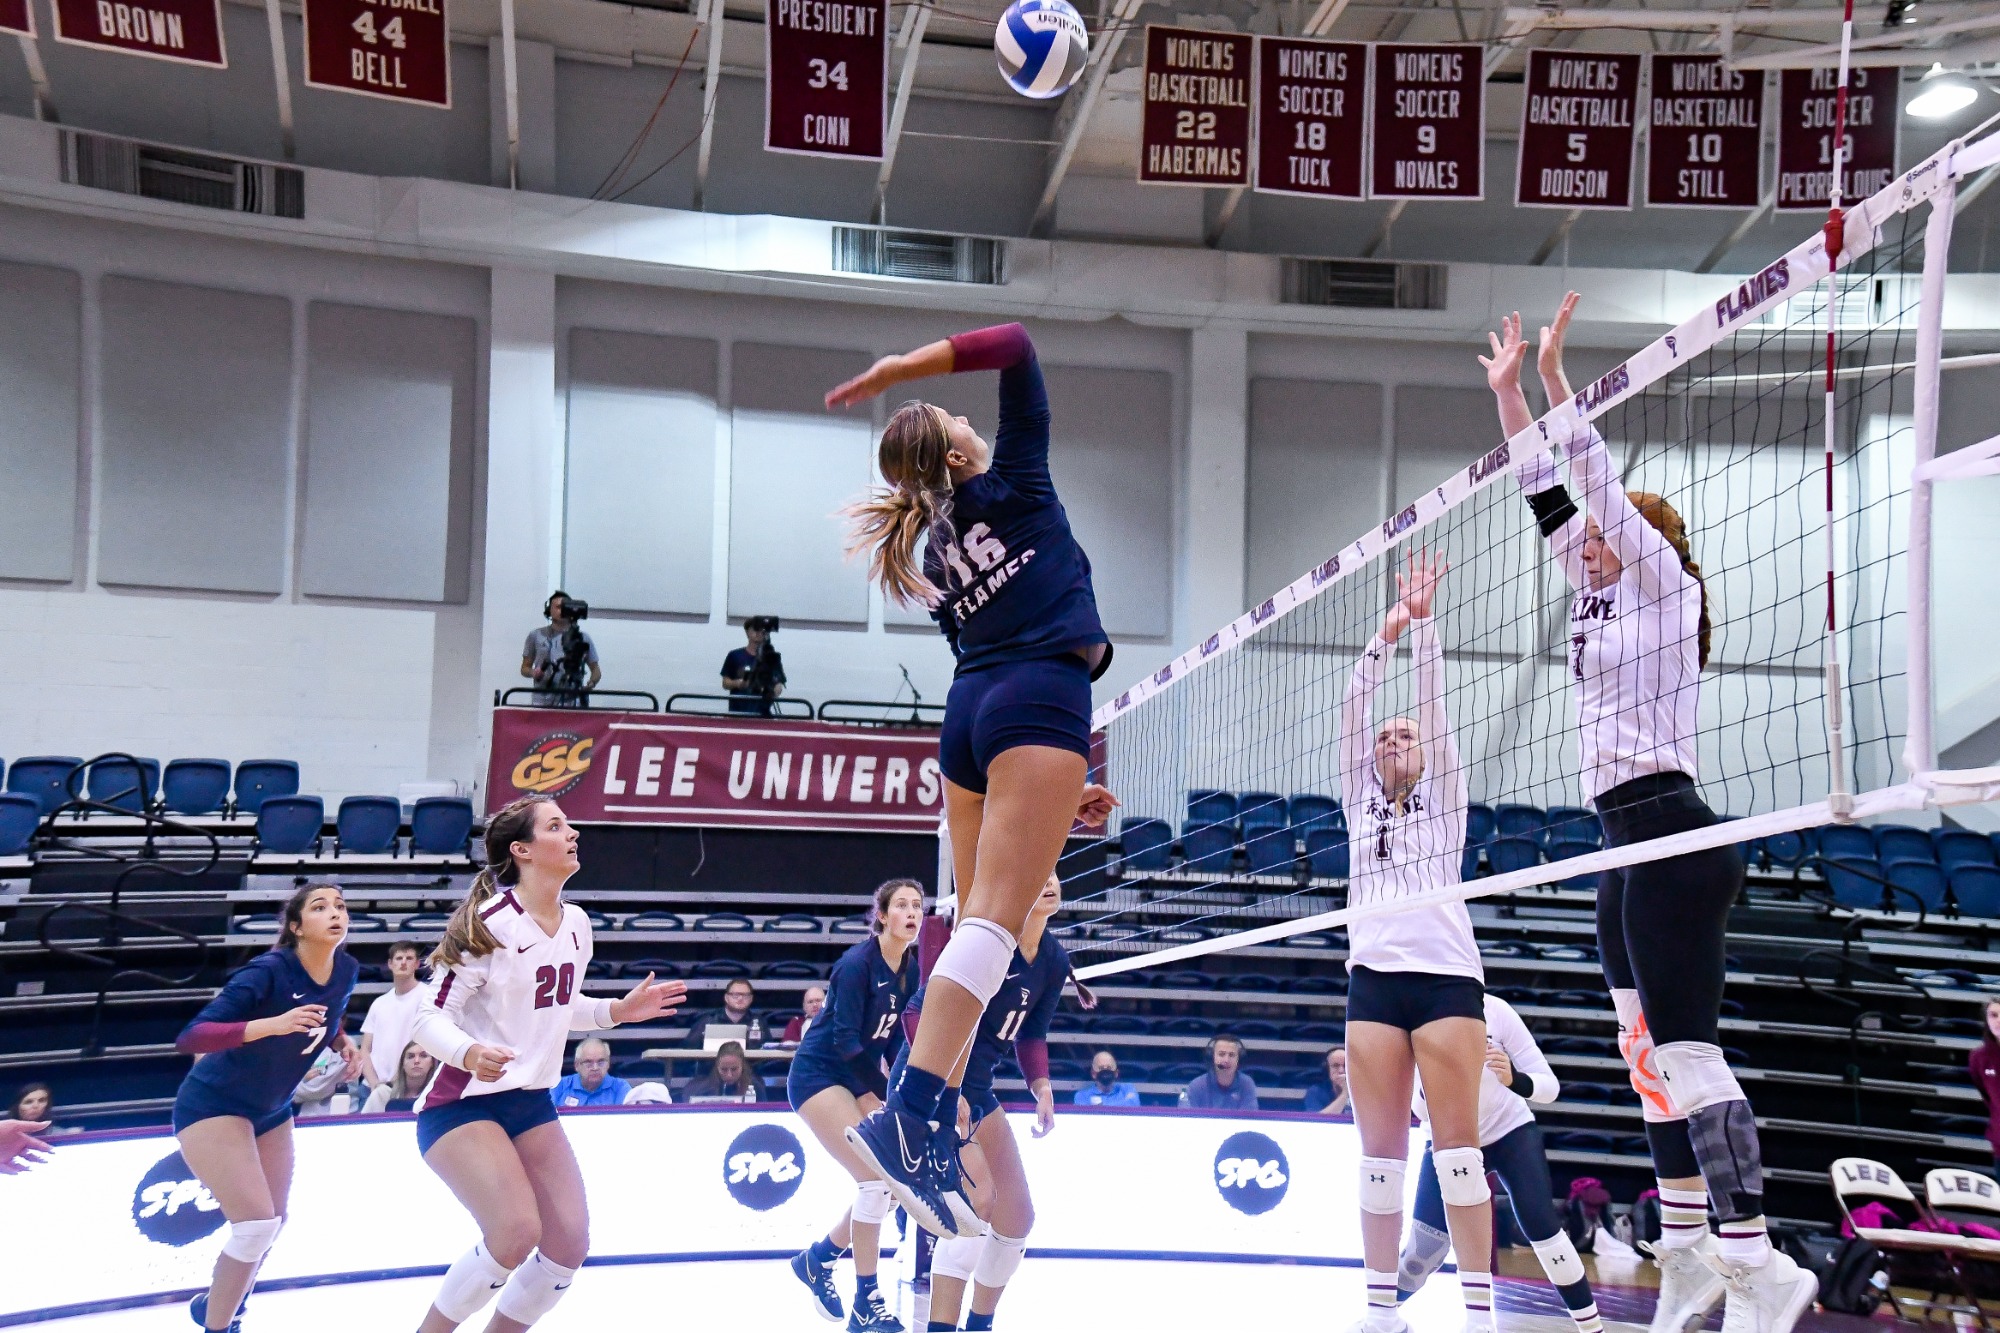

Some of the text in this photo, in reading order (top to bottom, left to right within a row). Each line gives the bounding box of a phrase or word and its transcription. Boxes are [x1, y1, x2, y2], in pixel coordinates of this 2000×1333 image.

[99, 1, 184, 50] BROWN
[351, 10, 407, 49] 44
[779, 0, 877, 37] PRESIDENT
[352, 48, 407, 88] BELL
[1166, 37, 1234, 71] WOMENS
[1279, 48, 1348, 81] WOMENS
[1395, 53, 1463, 82] WOMENS
[808, 58, 848, 91] 34
[1148, 72, 1247, 108] BASKETBALL
[1549, 59, 1619, 91] WOMENS
[1672, 62, 1744, 92] WOMENS
[1279, 85, 1344, 118] SOCCER
[1395, 89, 1460, 118] SOCCER
[1530, 95, 1631, 128] BASKETBALL
[1653, 98, 1757, 128] BASKETBALL
[804, 114, 850, 147] CONN
[1176, 110, 1217, 140] 22
[1294, 121, 1327, 151] 18
[1417, 125, 1437, 154] 9
[1150, 144, 1241, 176] HABERMAS
[1567, 133, 1588, 163] 5
[1687, 134, 1722, 163] 10
[1289, 156, 1330, 187] TUCK
[1395, 160, 1459, 189] NOVAES
[1540, 168, 1608, 199] DODSON
[1678, 169, 1727, 199] STILL
[1715, 257, 1789, 328] FLAMES
[1575, 362, 1630, 418] FLAMES
[1469, 441, 1511, 487] FLAMES
[946, 521, 1007, 588] 16
[511, 738, 594, 791] GSC
[604, 745, 699, 797] LEE
[1374, 823, 1391, 861] 1
[534, 962, 575, 1010] 20
[301, 1026, 328, 1055] 7
[871, 1013, 898, 1040] 12
[996, 1010, 1027, 1041] 11
[728, 1151, 802, 1184] SPG
[1217, 1157, 1287, 1189] SPG
[1841, 1163, 1891, 1186] LEE
[1935, 1175, 1993, 1199] LEE
